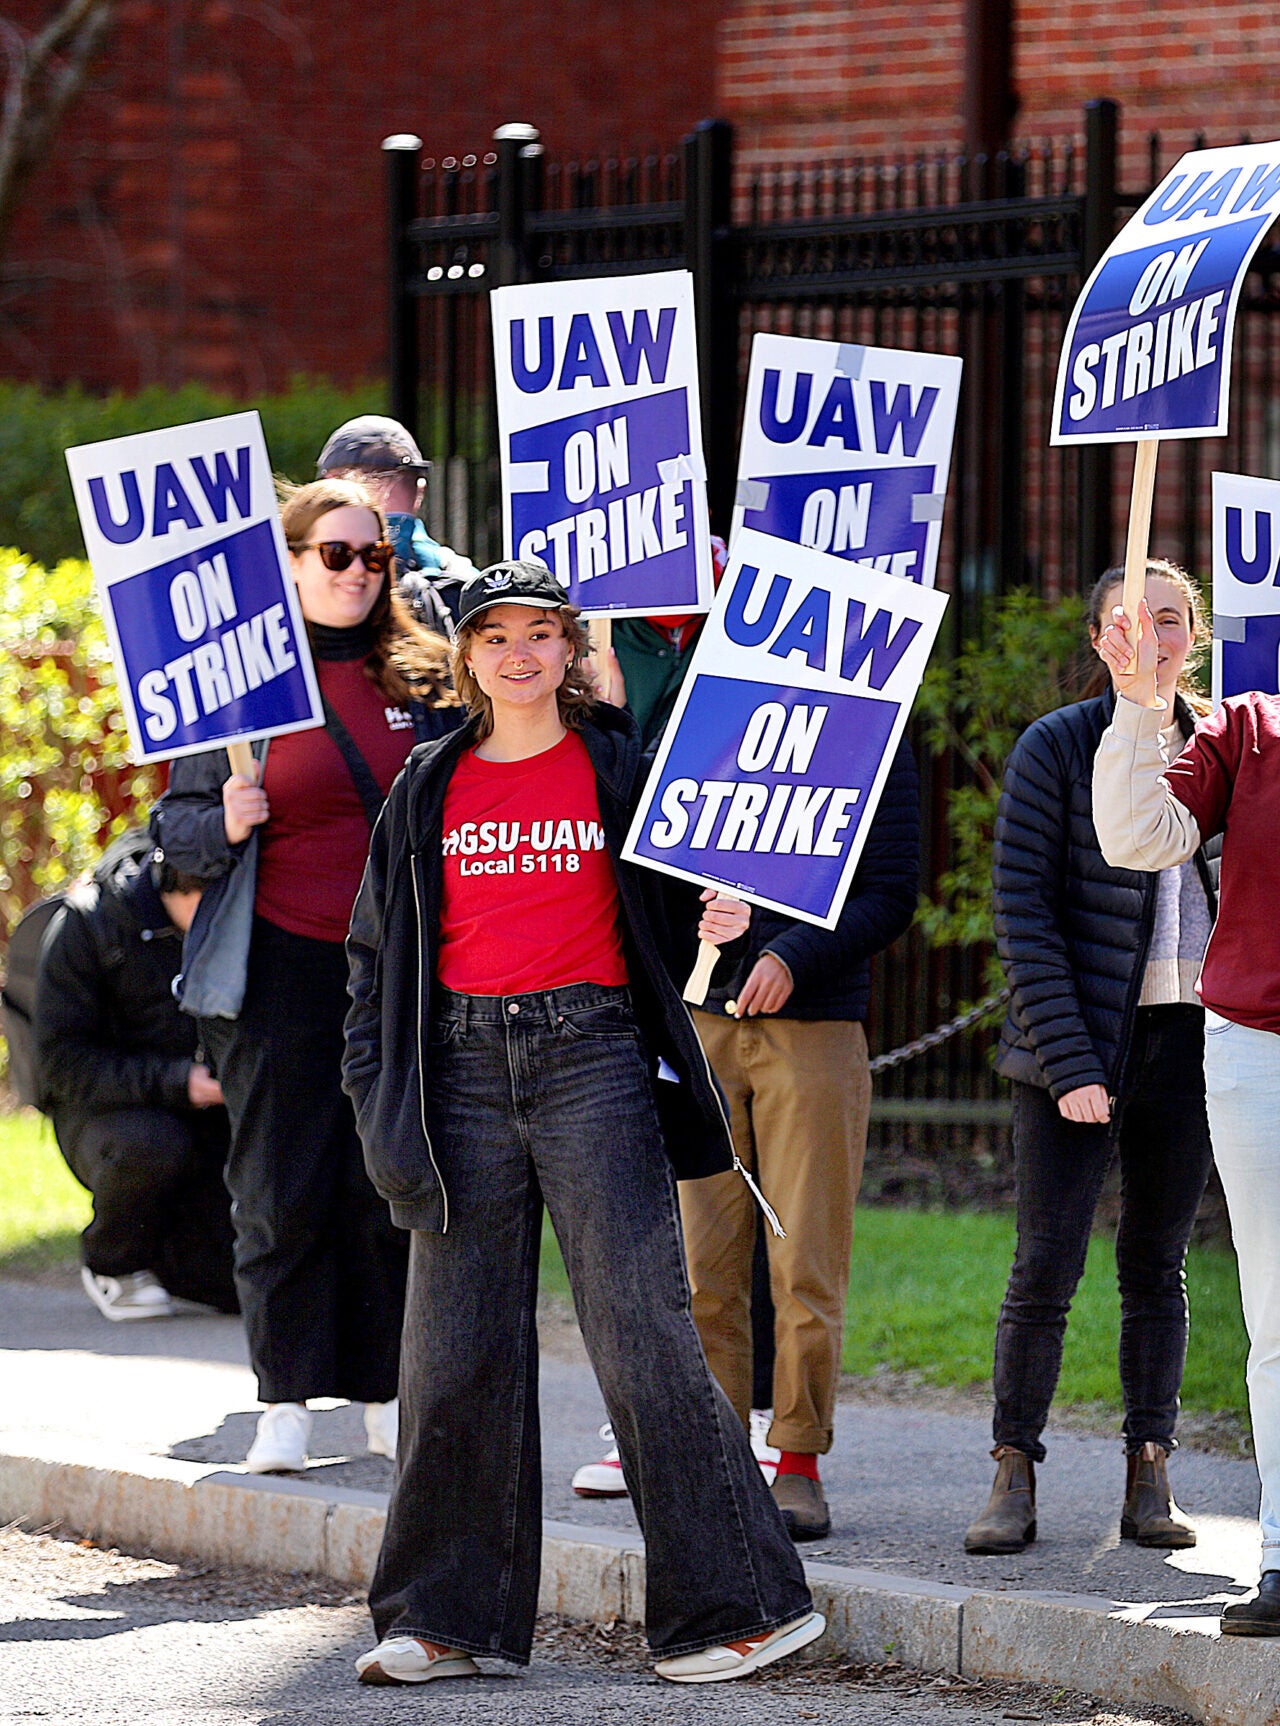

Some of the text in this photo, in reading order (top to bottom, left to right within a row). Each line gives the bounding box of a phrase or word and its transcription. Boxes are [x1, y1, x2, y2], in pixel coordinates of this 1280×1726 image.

[1128, 237, 1212, 317] ON
[509, 306, 678, 394] UAW
[1069, 289, 1225, 421] STRIKE
[759, 368, 941, 458] UAW
[87, 446, 253, 545] UAW
[563, 415, 630, 504] ON
[800, 482, 873, 553] ON
[169, 552, 238, 644] ON
[722, 563, 924, 692] UAW
[137, 602, 296, 743] STRIKE
[736, 701, 829, 775] ON
[648, 777, 862, 858] STRIKE
[460, 853, 581, 877] Local 5118
